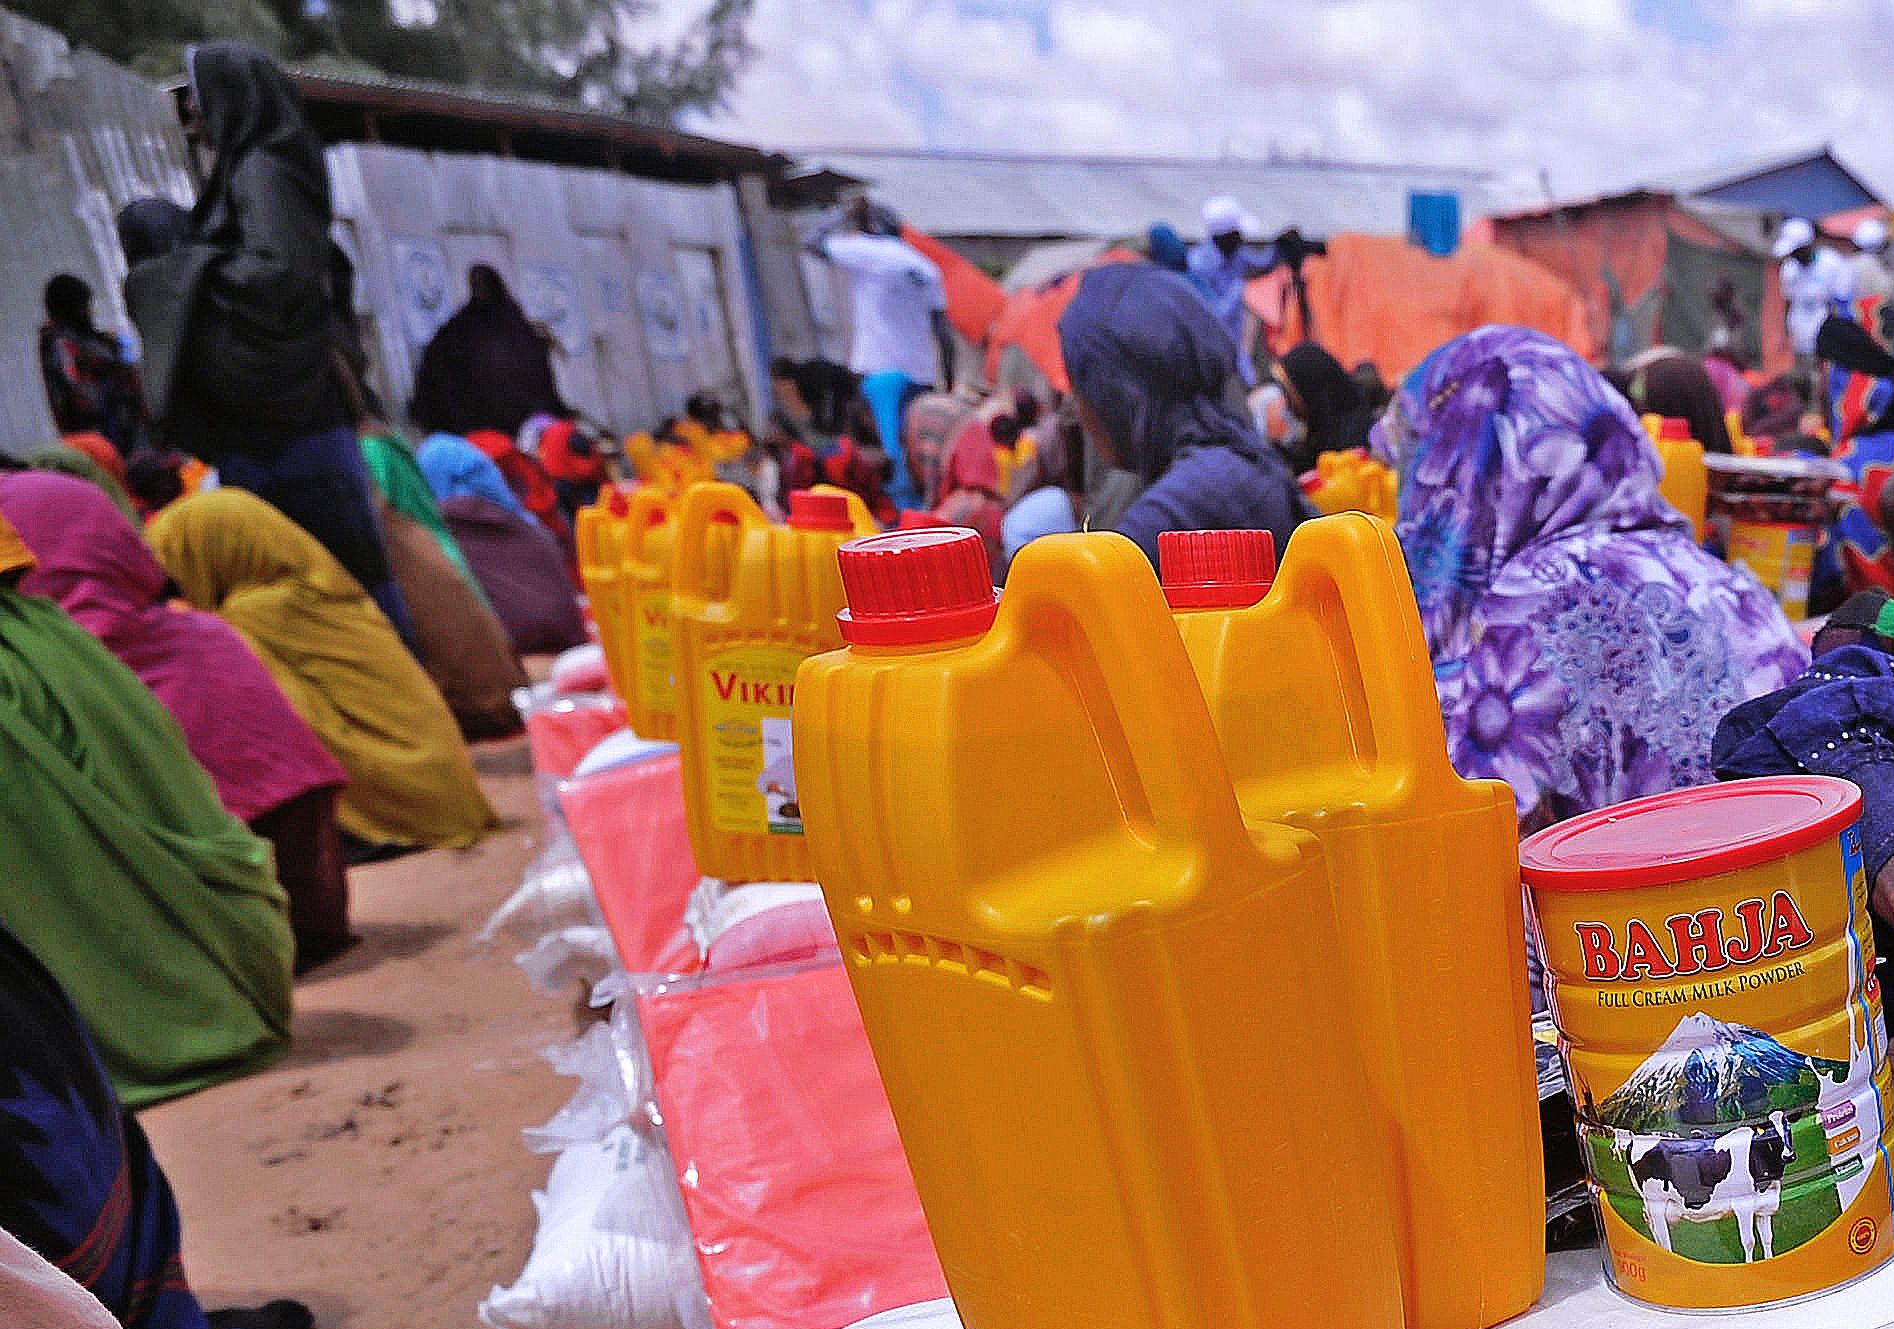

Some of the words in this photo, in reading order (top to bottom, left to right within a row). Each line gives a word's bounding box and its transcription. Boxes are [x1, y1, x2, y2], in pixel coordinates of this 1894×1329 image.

[710, 671, 794, 706] VIKI
[1575, 889, 1814, 982] BAHJA
[1598, 991, 1629, 1008] FULL
[1632, 987, 1688, 1007] CREAM
[1693, 980, 1736, 1004] MILK
[1739, 962, 1805, 992] POWDER
